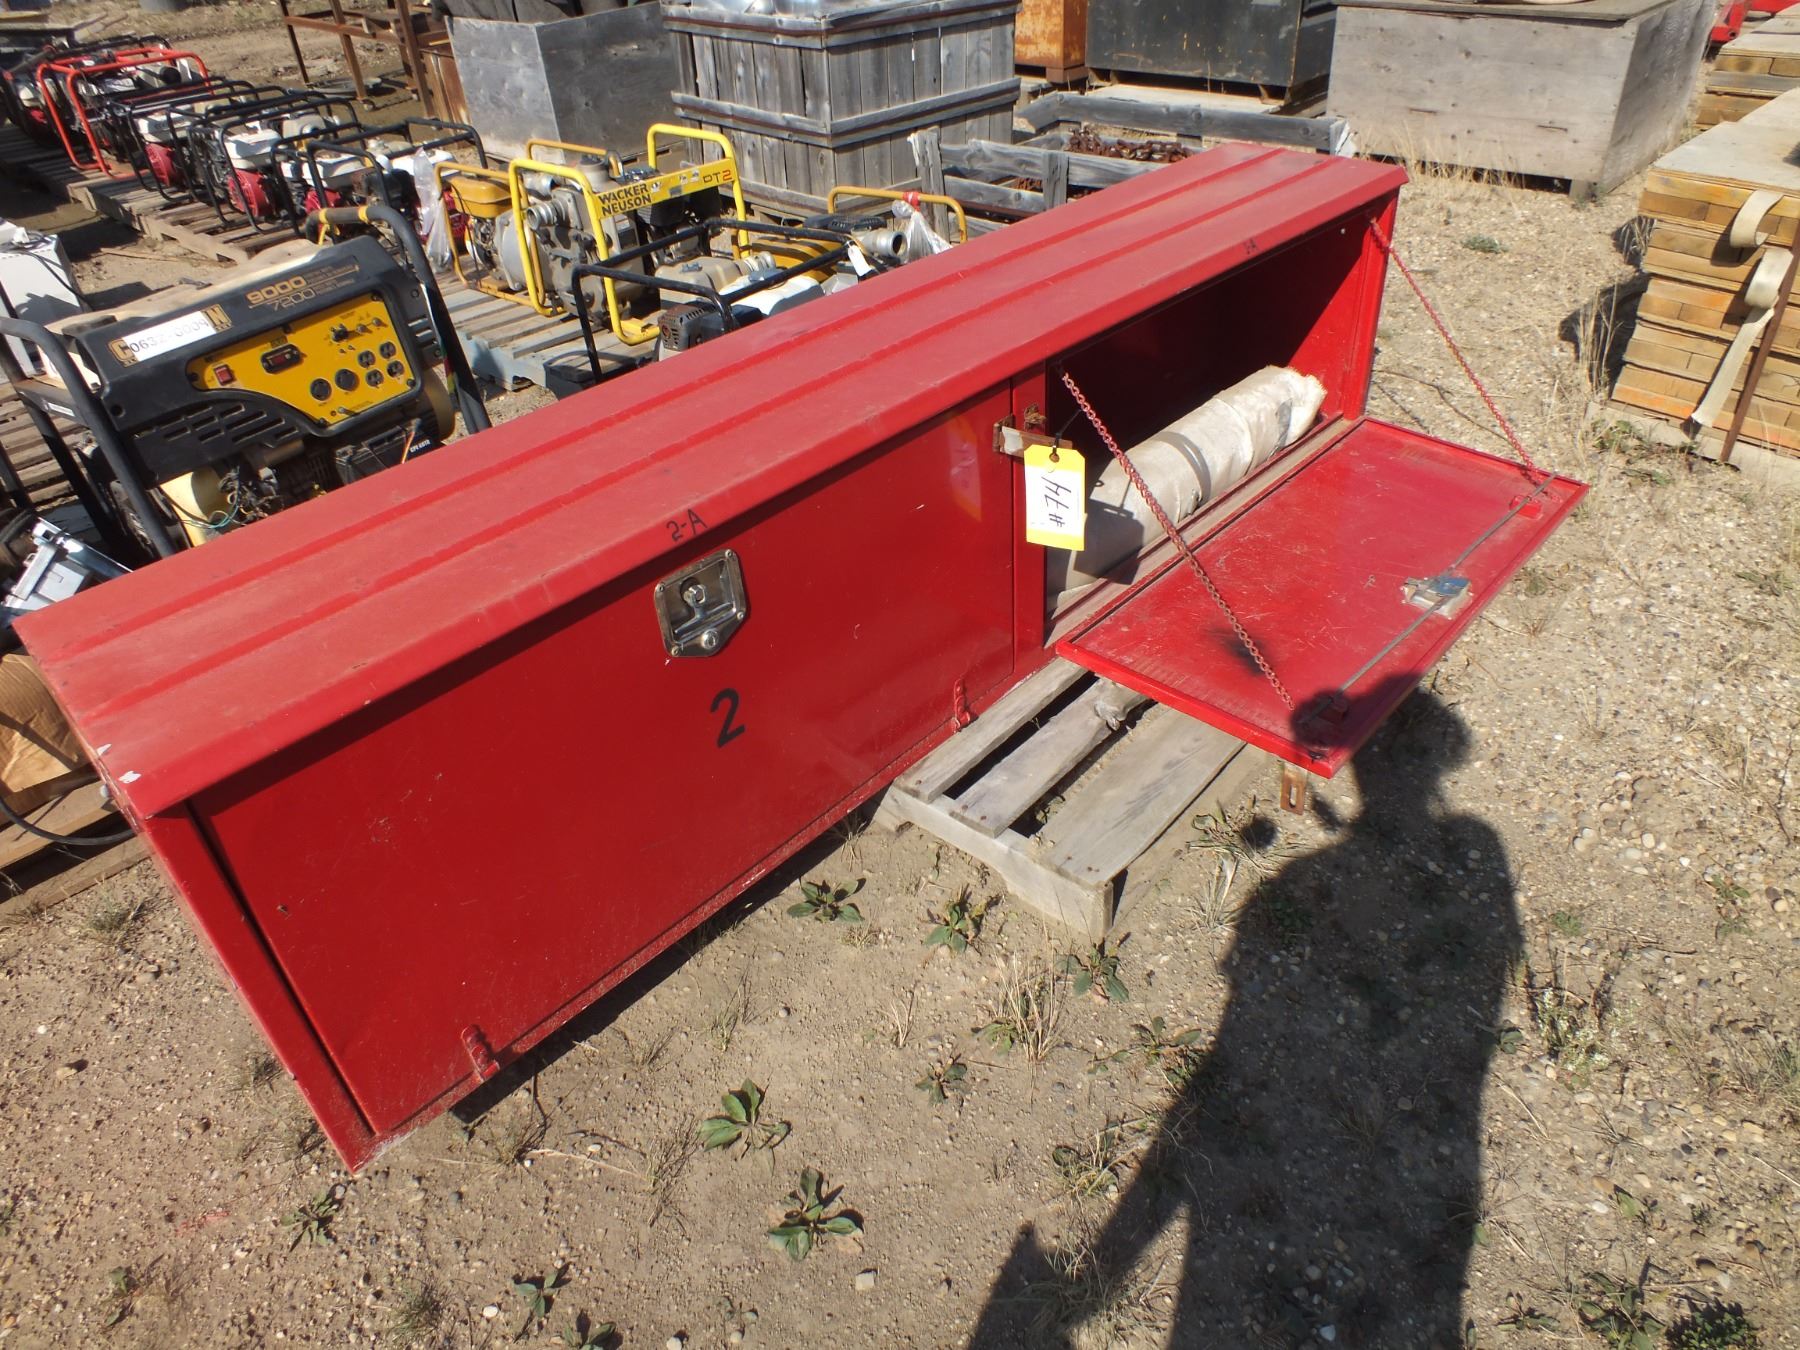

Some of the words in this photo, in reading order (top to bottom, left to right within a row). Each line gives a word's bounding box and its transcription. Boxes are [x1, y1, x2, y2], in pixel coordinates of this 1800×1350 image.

[703, 169, 731, 184] DT2
[598, 184, 649, 205] WACKER
[602, 194, 651, 216] NEUSON
[246, 275, 307, 304] 9000
[267, 288, 316, 311] 7200
[666, 508, 707, 542] 2-A
[710, 687, 746, 748] 2
